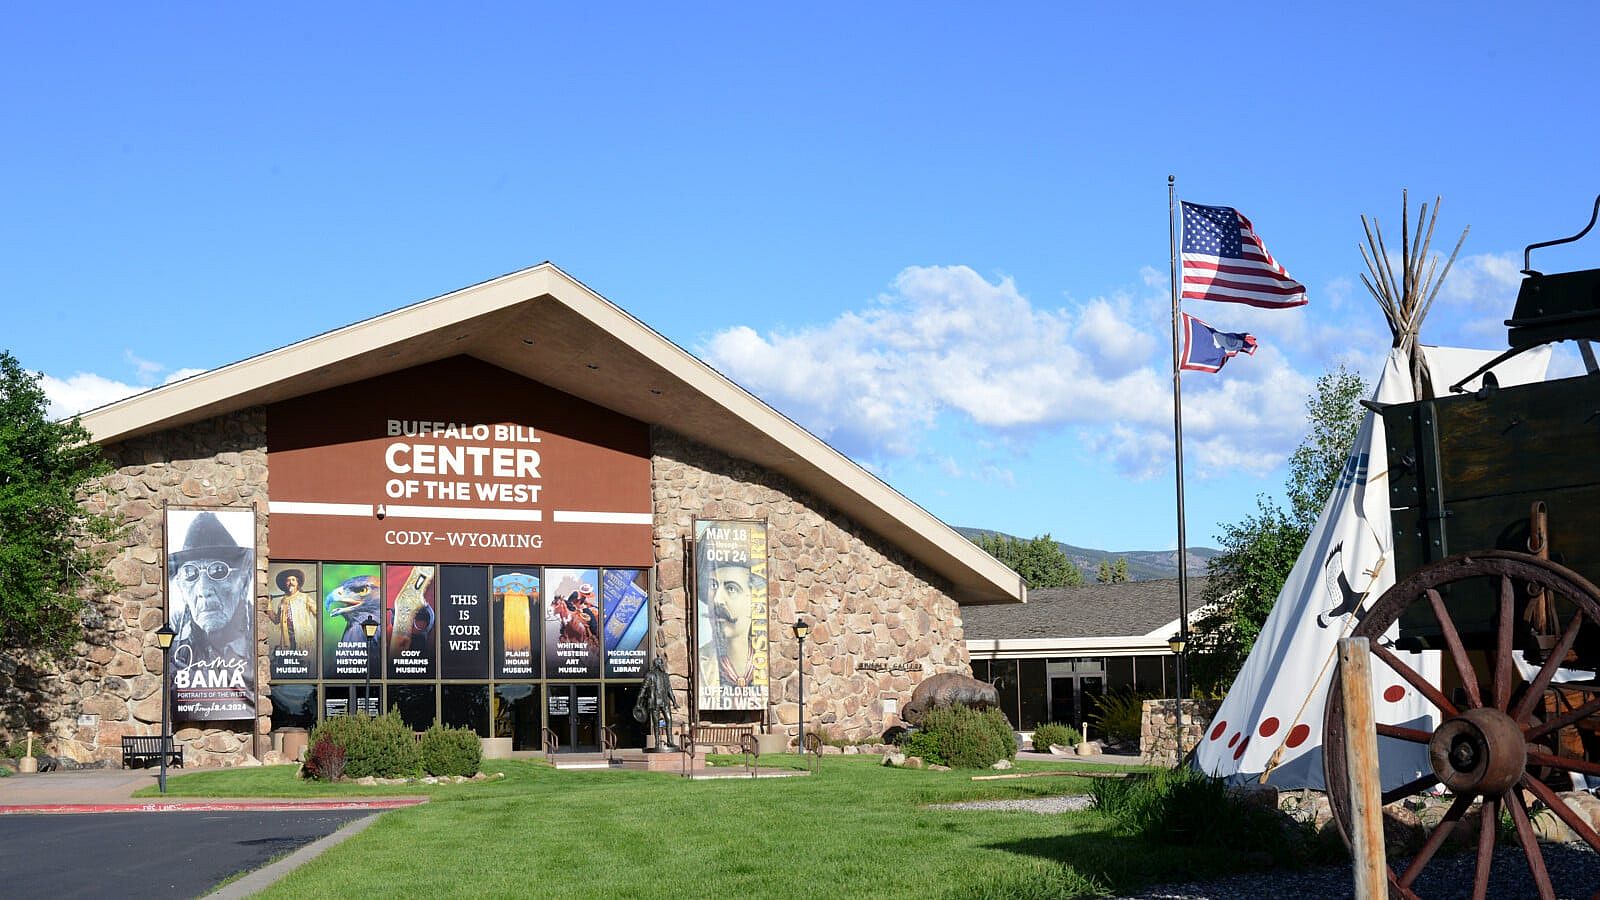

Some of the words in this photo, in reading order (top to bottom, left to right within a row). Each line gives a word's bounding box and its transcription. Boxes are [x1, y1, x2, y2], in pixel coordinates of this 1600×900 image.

[387, 419, 490, 441] BUFFALO
[494, 424, 541, 443] BILL
[385, 442, 542, 479] CENTER
[385, 478, 420, 499] OF
[422, 480, 471, 501] THE
[474, 483, 542, 503] WEST
[706, 527, 730, 540] MAY
[732, 528, 747, 541] 18
[706, 549, 730, 561] OCT
[732, 550, 747, 563] 24
[750, 528, 768, 580] ART
[450, 594, 478, 606] THIS
[459, 610, 470, 621] IS
[448, 625, 480, 636] YOUR
[751, 585, 769, 686] POSTER
[448, 640, 481, 651] WEST
[174, 644, 248, 685] James
[276, 666, 308, 674] MUSEUM
[176, 669, 246, 689] BAMA
[177, 704, 194, 712] NOW
